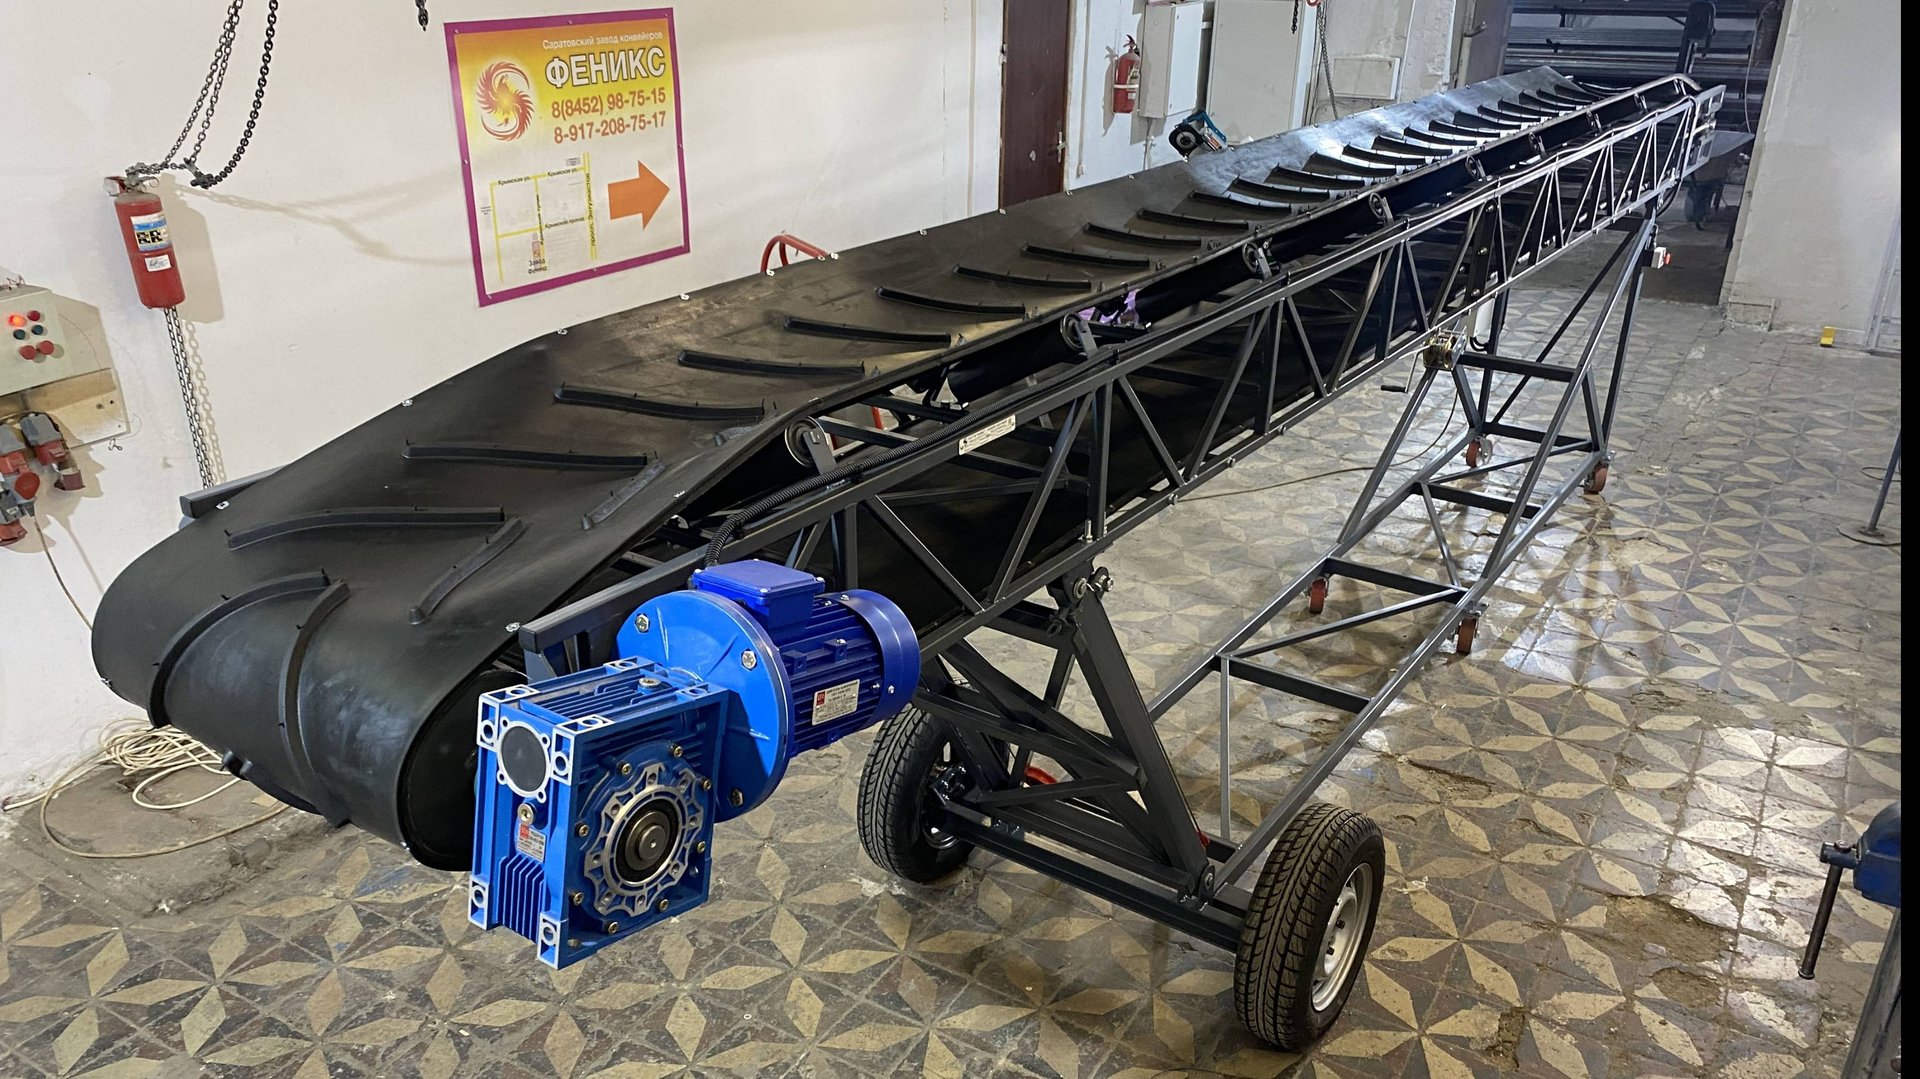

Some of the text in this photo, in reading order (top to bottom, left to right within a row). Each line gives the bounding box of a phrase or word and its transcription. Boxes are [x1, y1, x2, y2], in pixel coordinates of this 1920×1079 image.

[542, 31, 663, 50] Саратовский завод конвейеров
[545, 45, 666, 88] ФЕНИКС
[551, 87, 666, 120] 8(8452) 98-75-15
[554, 111, 666, 144] 8-917-208-75-17
